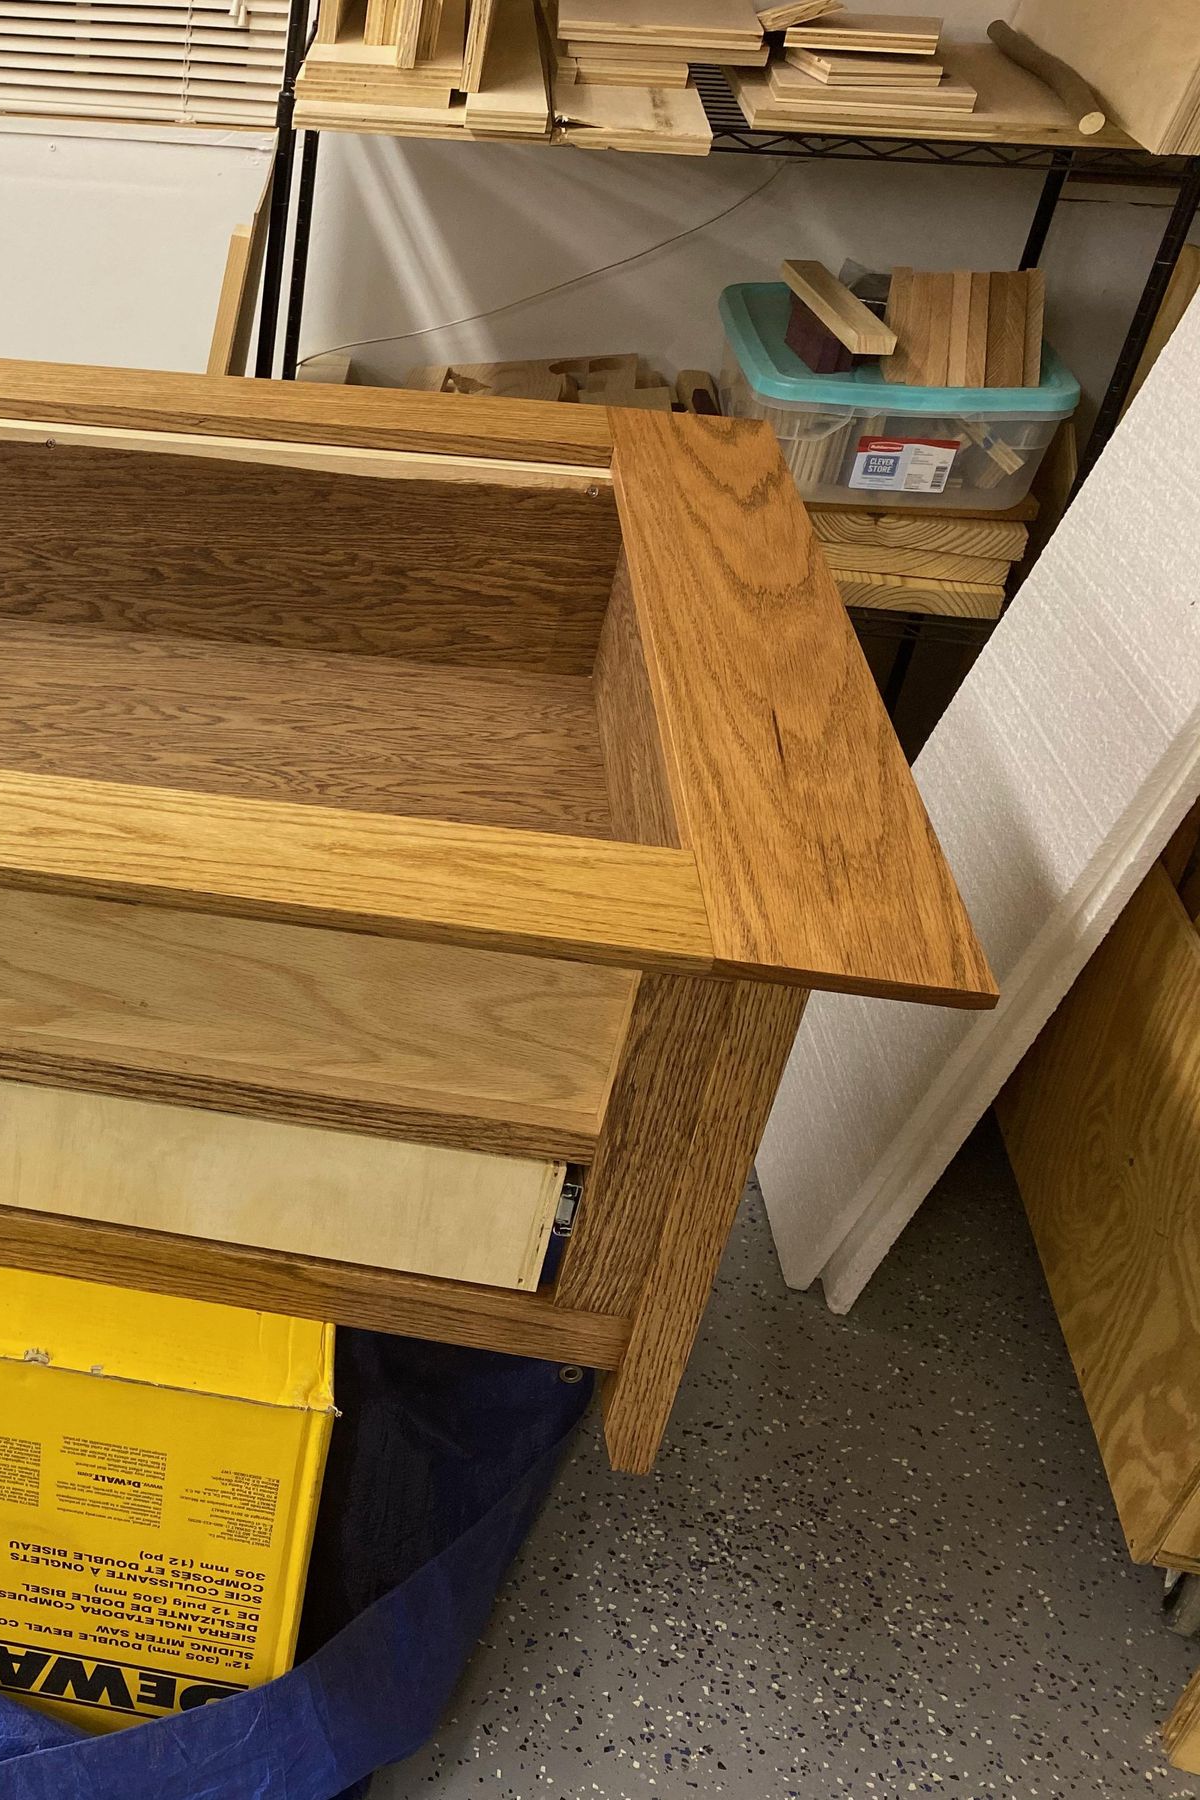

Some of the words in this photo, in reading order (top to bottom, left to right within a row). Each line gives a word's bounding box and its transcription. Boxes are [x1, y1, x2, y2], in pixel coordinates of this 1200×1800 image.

[870, 457, 894, 465] CLEVER
[867, 464, 893, 473] STORE
[9, 1540, 67, 1557] BISEAU
[10, 1552, 84, 1572] ONGLETS
[73, 1551, 138, 1570] DOUBLE
[139, 1550, 163, 1561] po)
[168, 1557, 193, 1568] (12
[199, 1562, 229, 1572] mm
[89, 1566, 100, 1576] À
[144, 1565, 165, 1575] ET
[234, 1569, 265, 1580] 305
[106, 1569, 218, 1596] COULISSANTE
[170, 1569, 263, 1592] COMPOSÉS
[21, 1582, 65, 1598] BISEL
[94, 1583, 127, 1596] mm)
[71, 1592, 124, 1608] DOBLE
[132, 1592, 166, 1604] (305
[224, 1590, 262, 1603] SCIE
[130, 1602, 152, 1613] DE
[172, 1597, 206, 1610] pulg
[211, 1606, 230, 1615] 12
[237, 1610, 259, 1621] DE
[80, 1604, 192, 1632] INGLETADORA
[157, 1607, 257, 1632] DESLIZANTE
[24, 1622, 72, 1637] BEVEL
[95, 1625, 129, 1637] SAW
[197, 1626, 256, 1643] SIERRA
[78, 1632, 142, 1650] DOUBLE
[134, 1632, 184, 1647] MITER
[147, 1644, 180, 1656] mm)
[190, 1642, 253, 1660] SLIDING
[185, 1652, 219, 1664] (305
[224, 1660, 250, 1670] 12"
